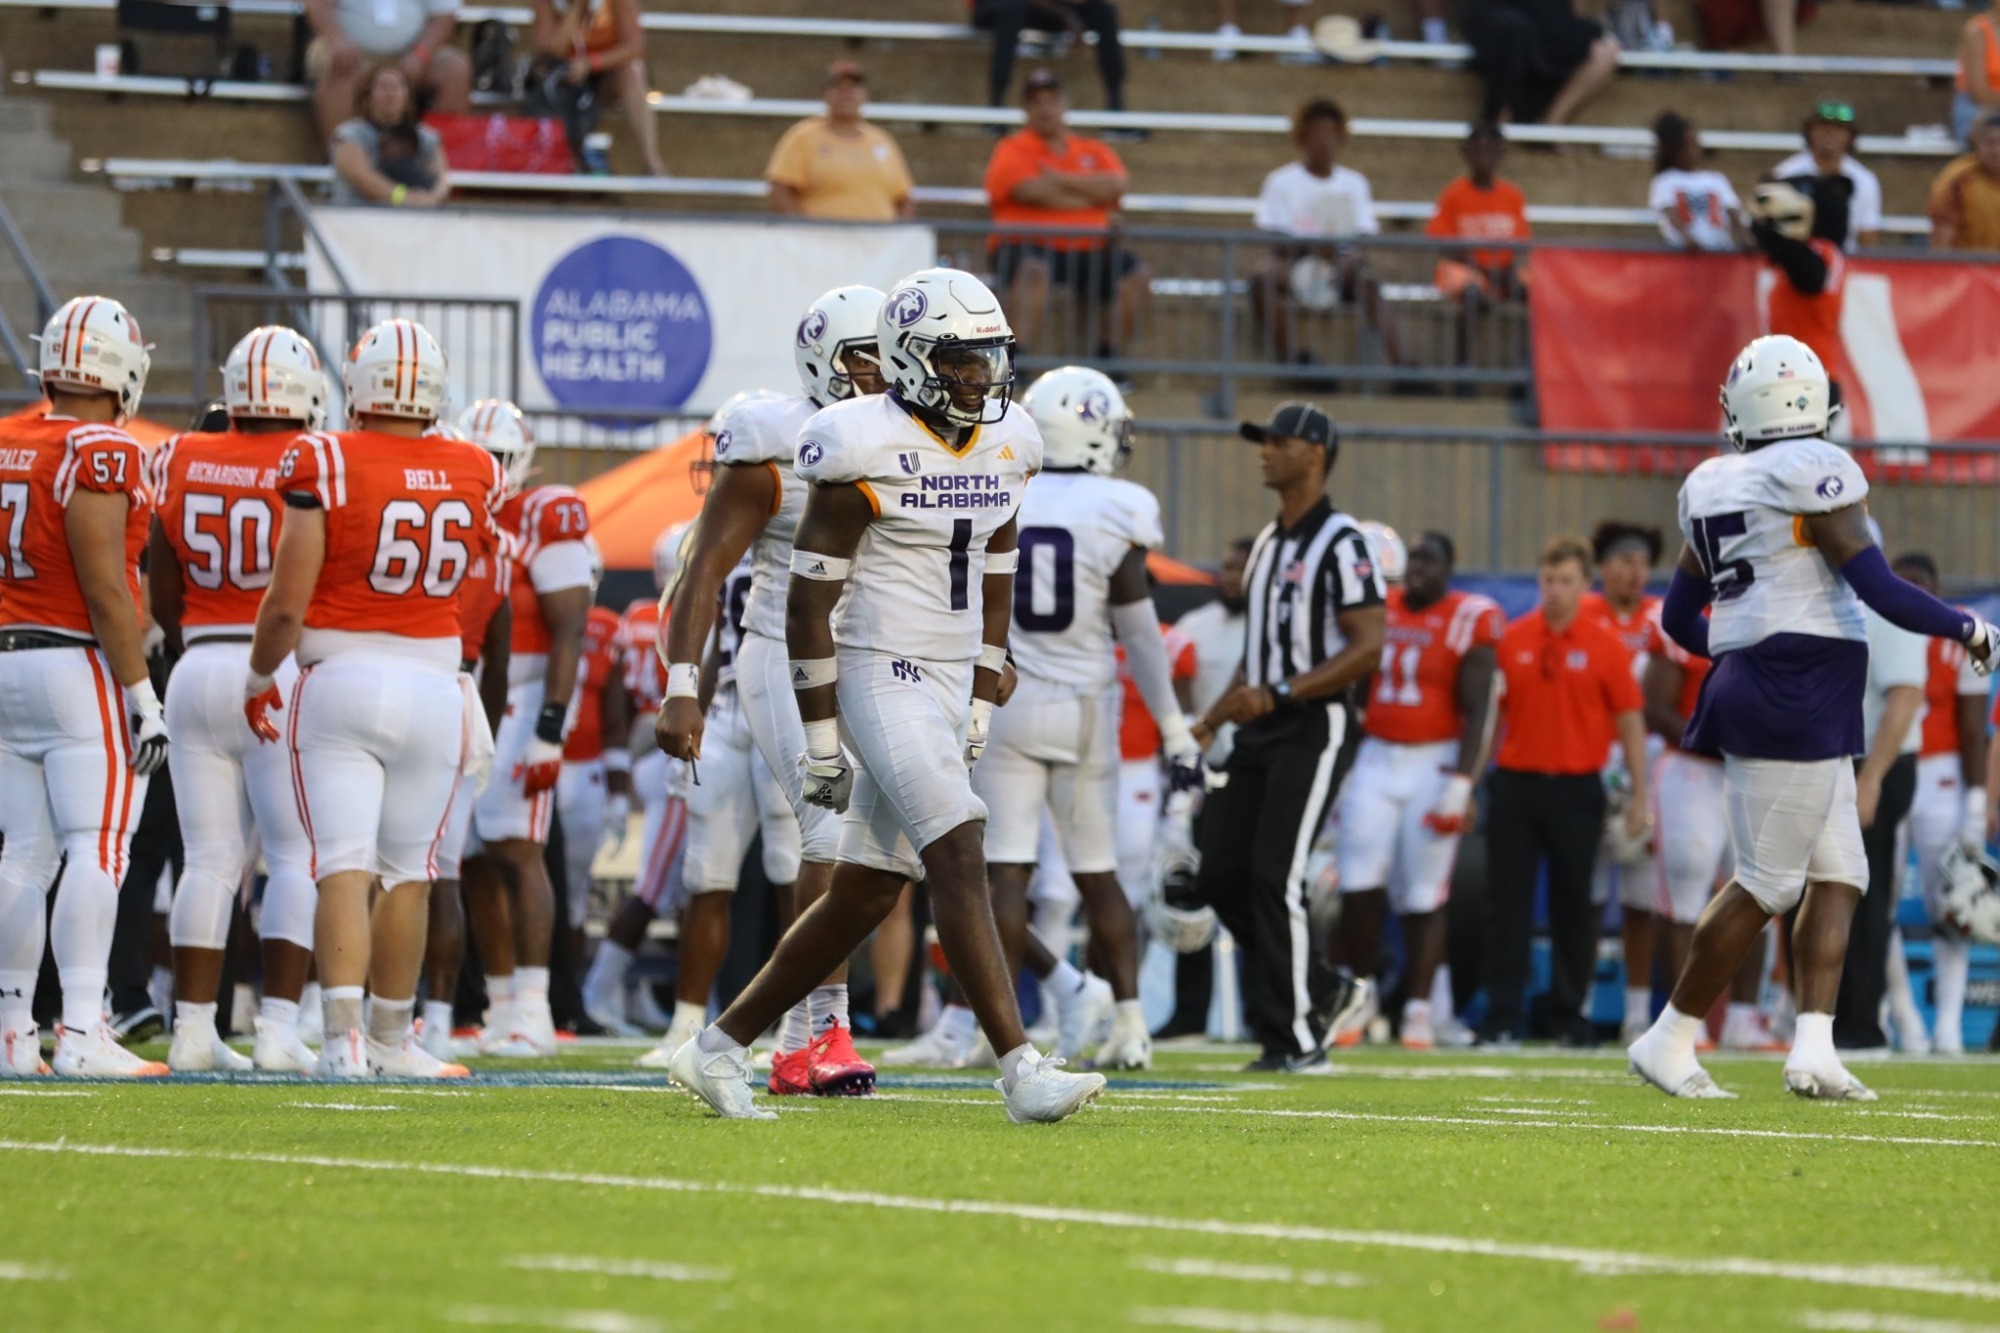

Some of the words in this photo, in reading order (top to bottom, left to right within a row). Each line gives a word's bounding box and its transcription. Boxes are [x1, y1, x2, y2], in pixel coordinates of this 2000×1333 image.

[545, 289, 703, 322] ALABAMA
[543, 319, 658, 351] PUBLIC
[976, 325, 1001, 333] Riddell
[542, 350, 667, 383] HEALTH
[92, 451, 126, 483] 57
[403, 469, 452, 491] BELL
[921, 475, 999, 491] NORTH
[901, 492, 1011, 509] ALABAMA
[0, 482, 37, 580] 7
[555, 502, 587, 533] 73
[183, 492, 273, 590] 50
[368, 499, 473, 597] 66
[950, 518, 972, 611] 1
[1377, 643, 1423, 706] 11
